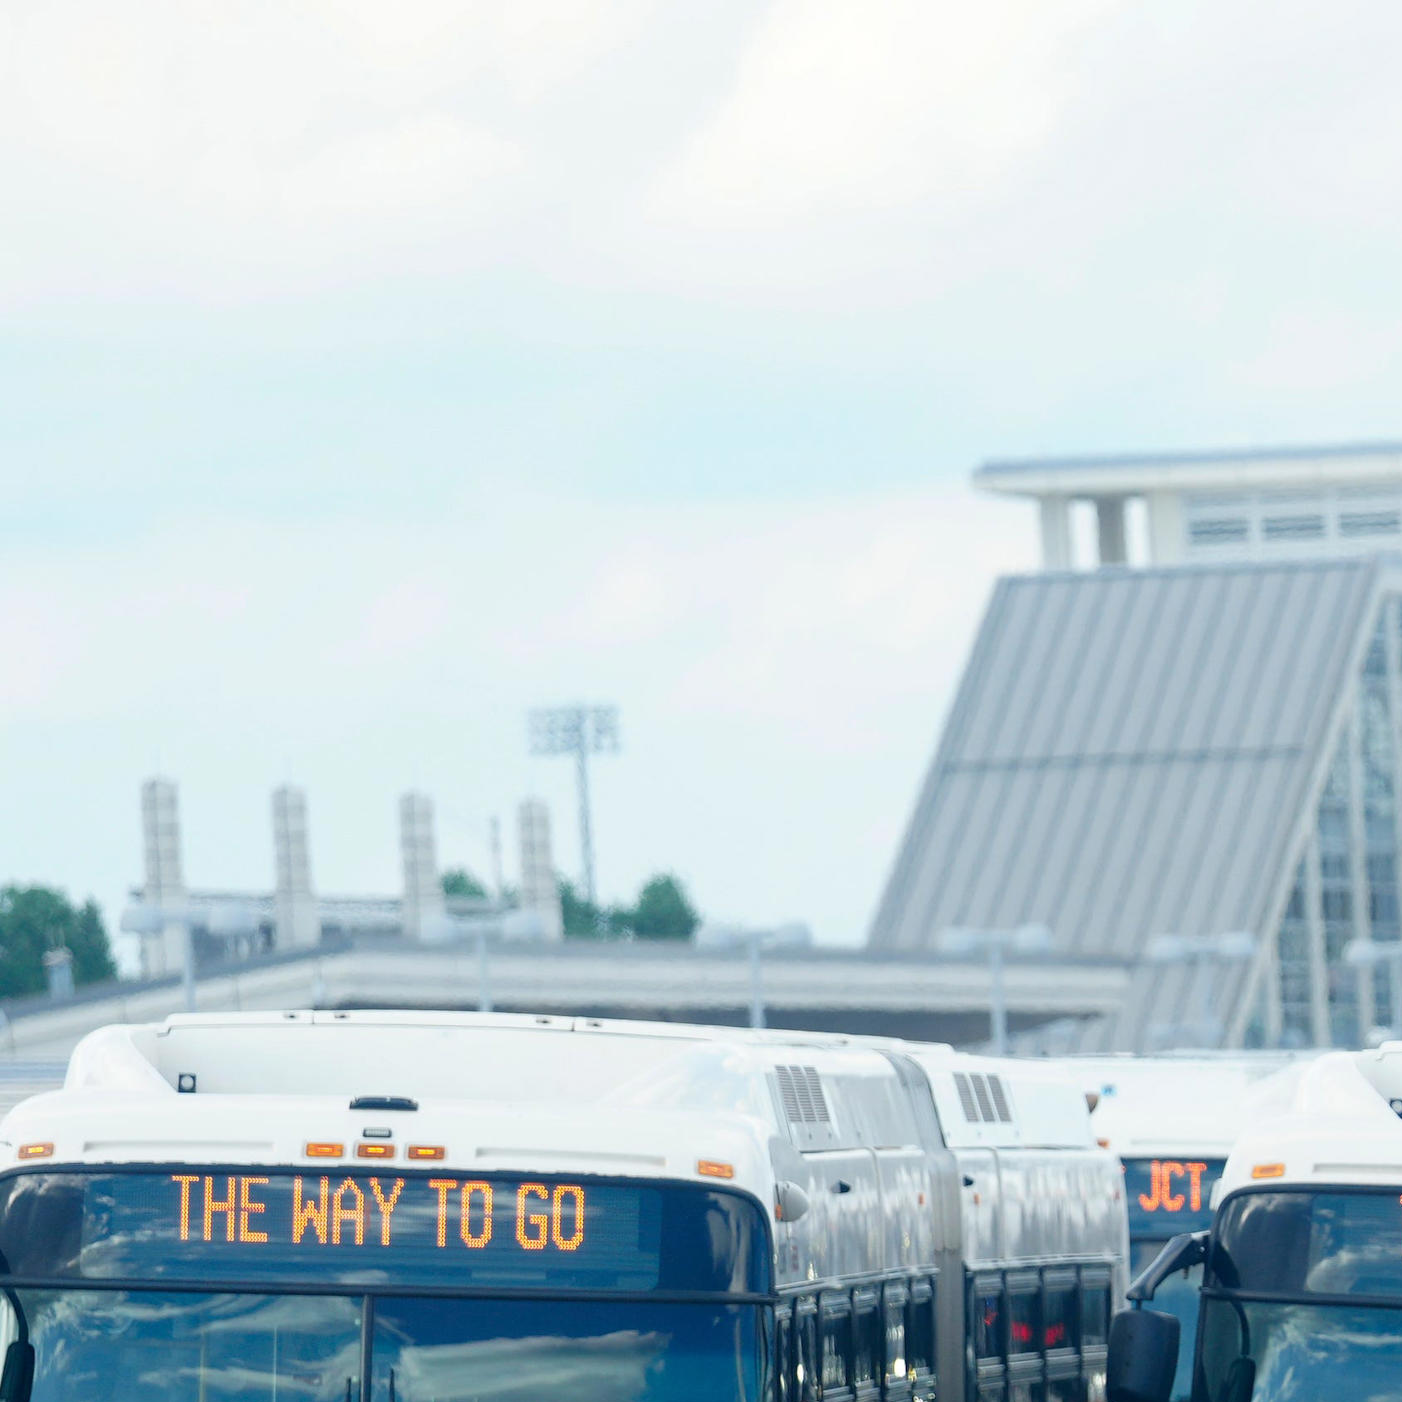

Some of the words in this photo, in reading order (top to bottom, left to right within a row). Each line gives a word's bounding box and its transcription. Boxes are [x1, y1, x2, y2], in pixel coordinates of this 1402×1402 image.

[172, 1174, 269, 1243] THE
[293, 1175, 405, 1246] WAY
[428, 1179, 493, 1249] TO
[516, 1183, 585, 1251] GO
[1139, 1160, 1207, 1212] JCT
